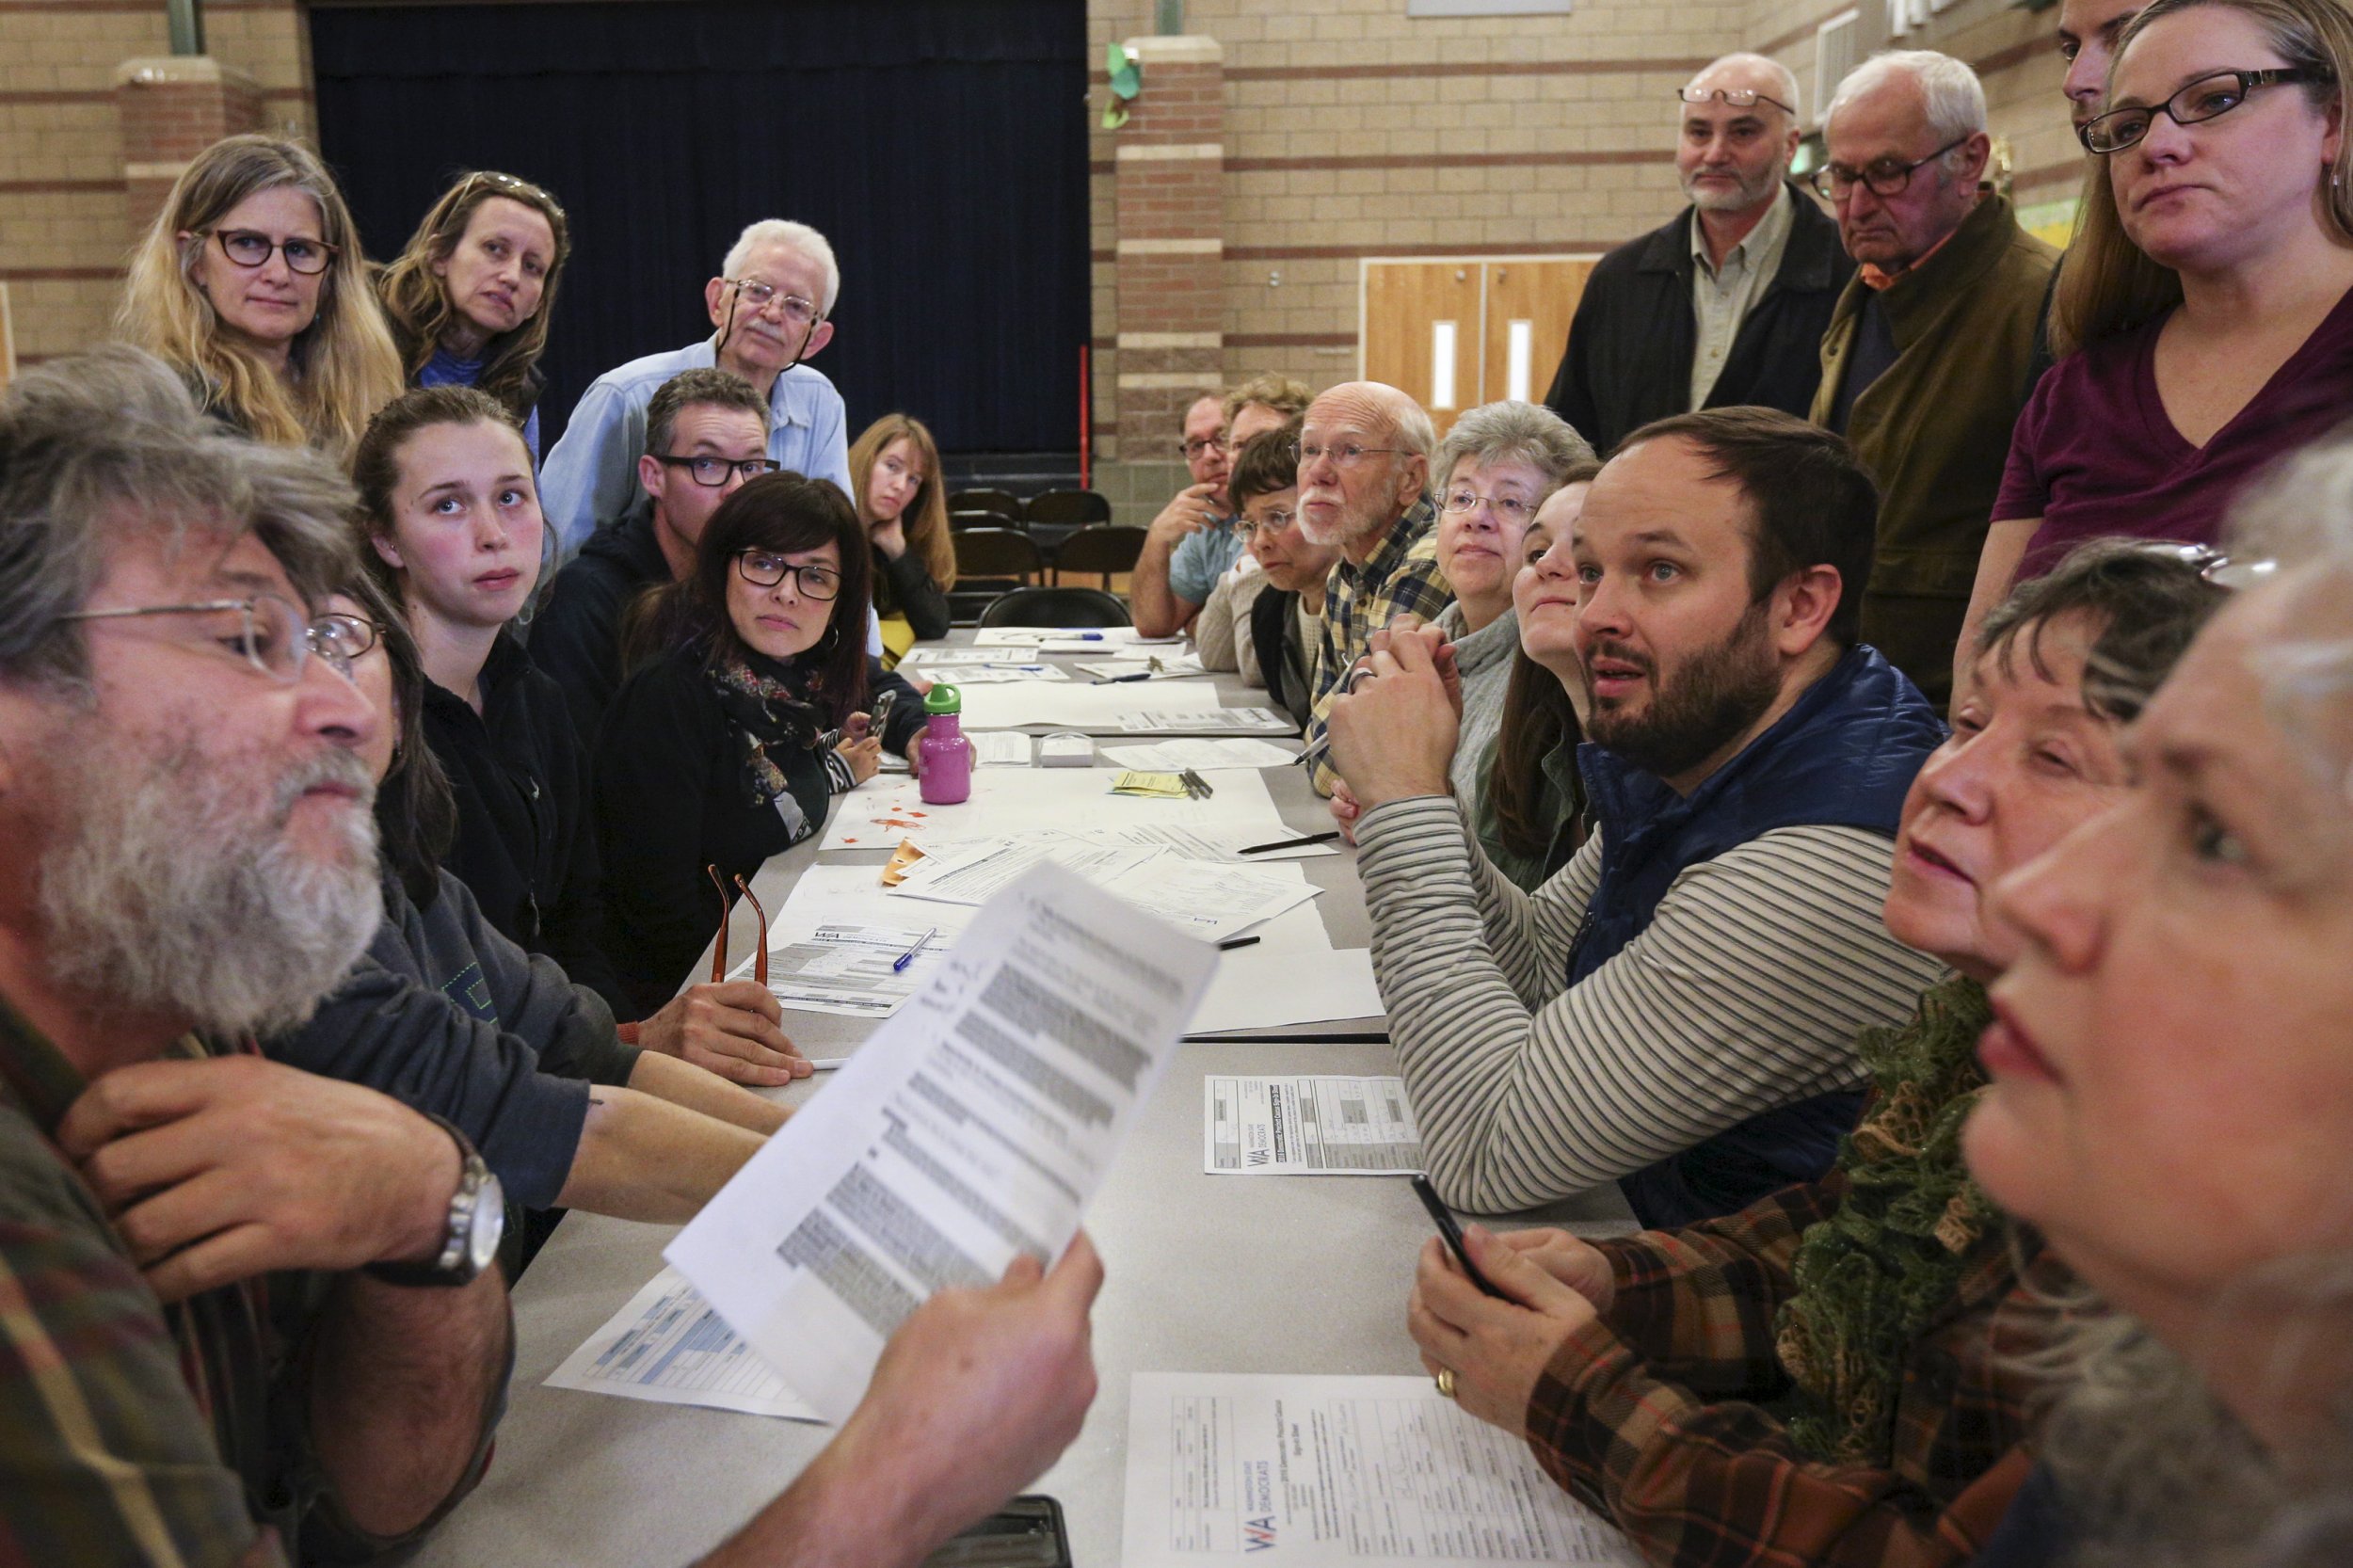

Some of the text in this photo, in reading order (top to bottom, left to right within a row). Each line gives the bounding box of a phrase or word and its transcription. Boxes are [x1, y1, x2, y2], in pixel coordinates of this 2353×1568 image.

[1257, 1123, 1267, 1147] DEMOCRATS
[1247, 1150, 1270, 1166] WA
[1277, 1441, 1288, 1467] Democratic
[1257, 1461, 1271, 1512] DEMOCRATS
[1243, 1515, 1276, 1553] WA
